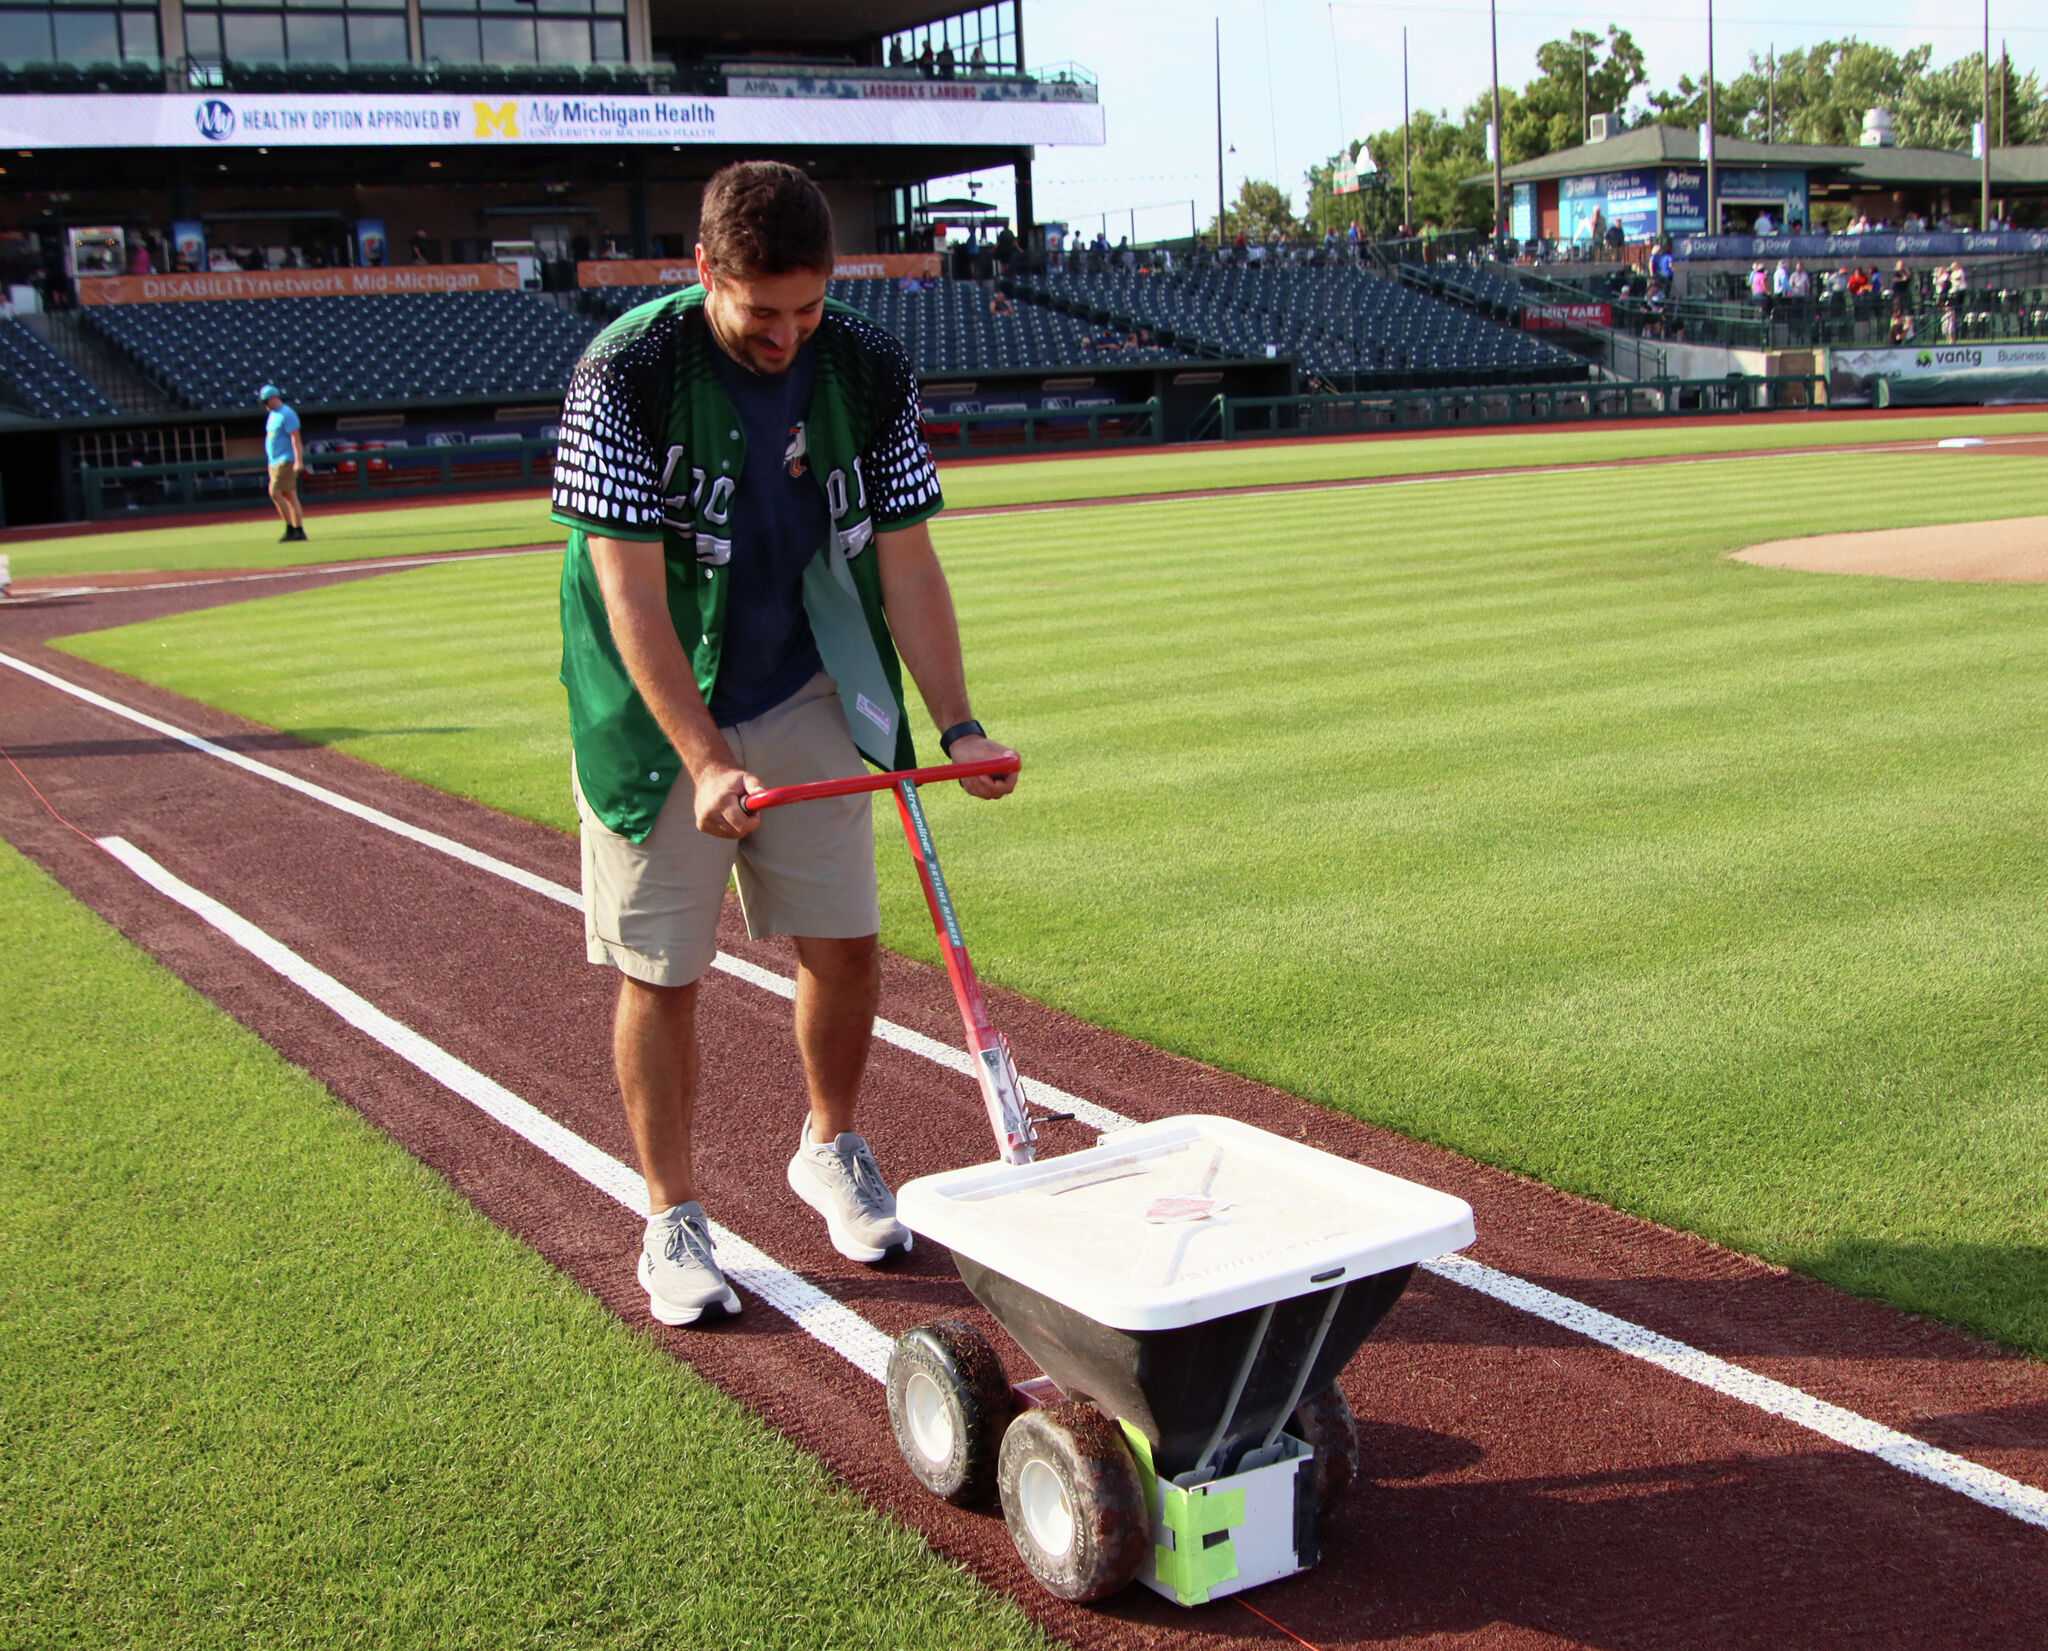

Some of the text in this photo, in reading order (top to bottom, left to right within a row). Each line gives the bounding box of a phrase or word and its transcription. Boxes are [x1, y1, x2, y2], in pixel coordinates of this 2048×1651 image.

[929, 85, 977, 98] LANDING
[243, 110, 461, 130] HEALTHY OPTION APPROVED BY
[656, 102, 715, 122] Health
[530, 128, 596, 137] UNIVERSITY
[616, 128, 671, 137] MICHIGAN
[674, 128, 716, 137] HEALTH
[1667, 193, 1689, 204] Make
[1682, 204, 1699, 216] Play
[143, 272, 480, 298] DISABILITYnetwork Mid-Michigan
[1936, 349, 2046, 366] vantg Business
[904, 781, 961, 946] streamliner DRYLINE MARKER
